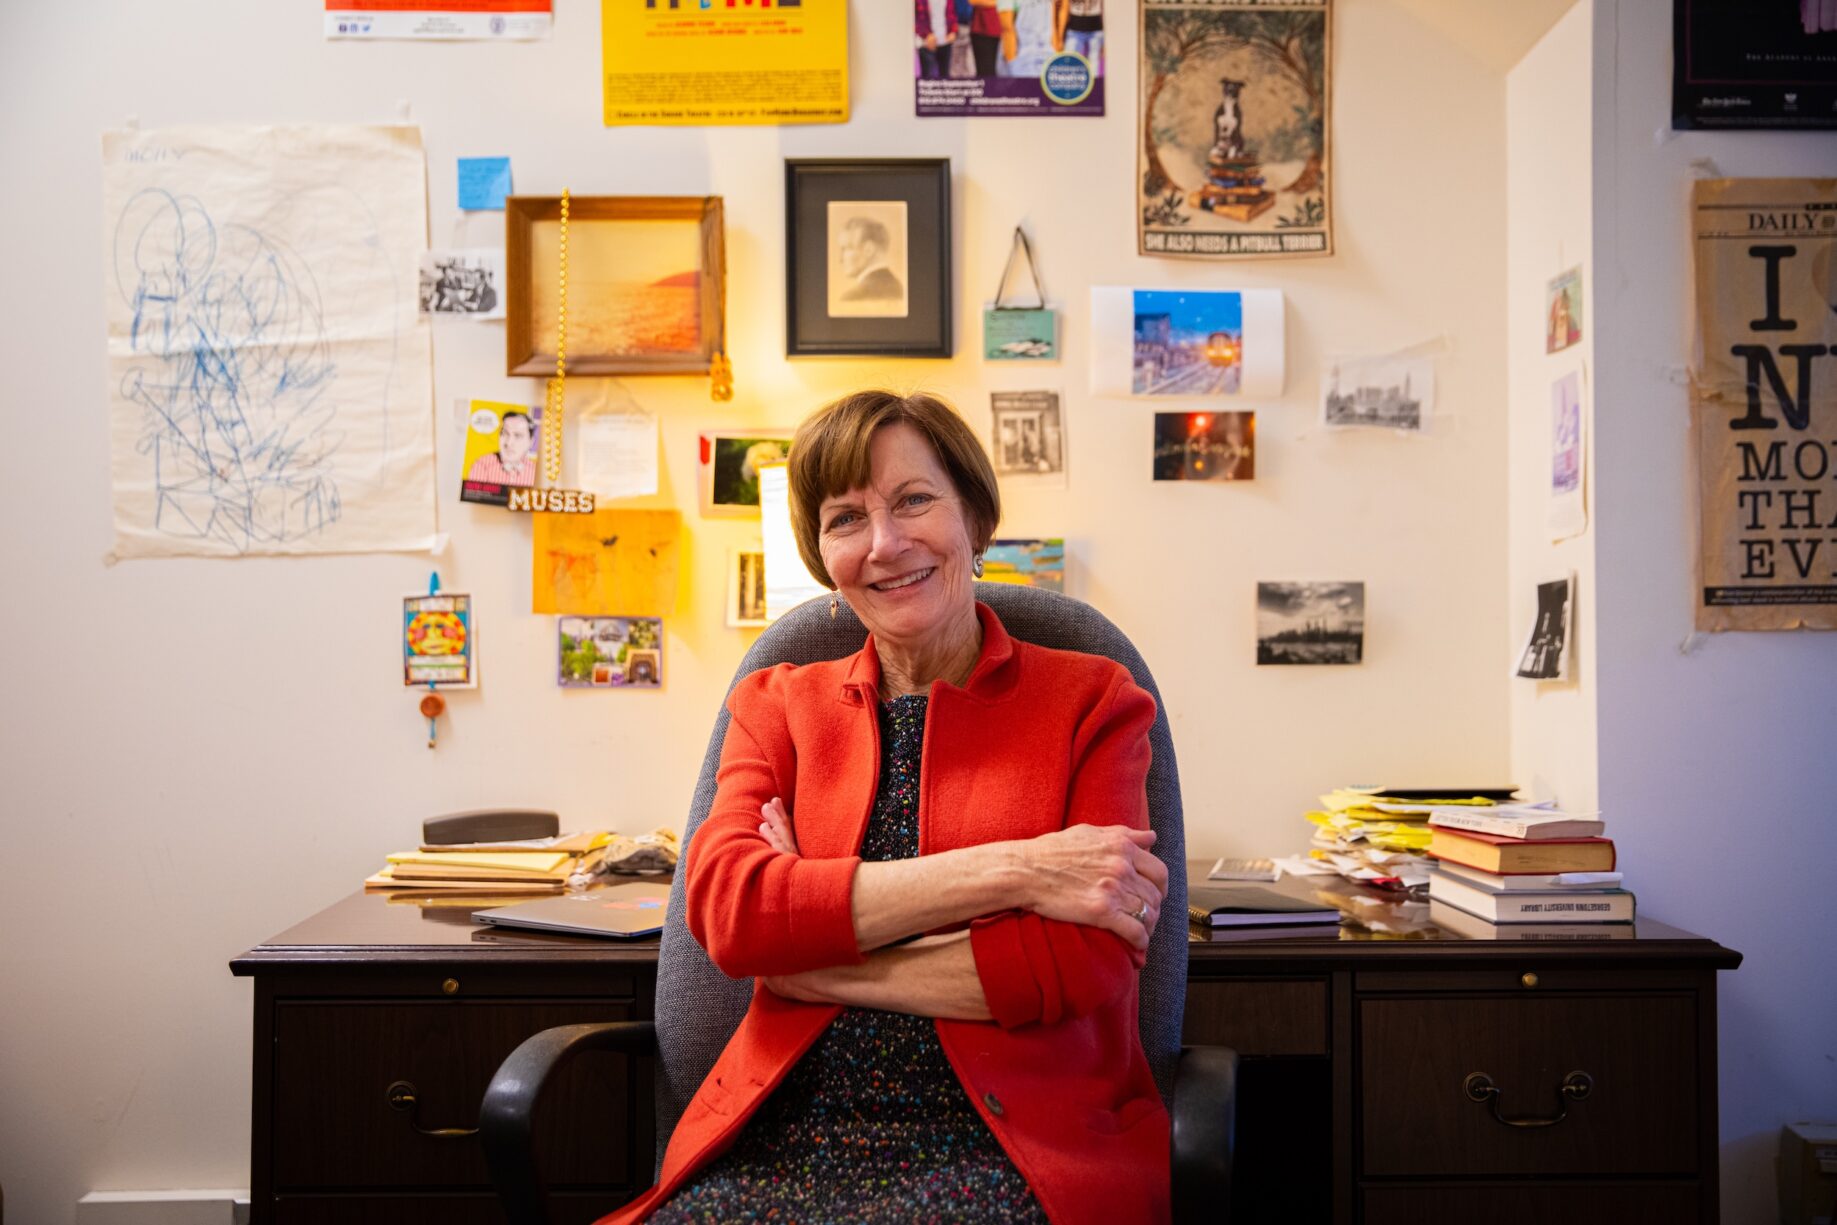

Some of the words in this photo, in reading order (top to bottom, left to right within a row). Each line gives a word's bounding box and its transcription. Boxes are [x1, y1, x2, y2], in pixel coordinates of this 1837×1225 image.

[1749, 213, 1818, 230] DAILY
[1230, 234, 1240, 252] A
[1748, 245, 1798, 331] I
[1729, 344, 1837, 430] N
[1736, 440, 1837, 482] MO
[508, 488, 593, 513] MUSES
[1739, 539, 1837, 579] EV
[1520, 904, 1543, 912] LIBRARY
[1544, 903, 1575, 912] UNIVERSITY
[1576, 903, 1611, 912] GEORGETOWN
